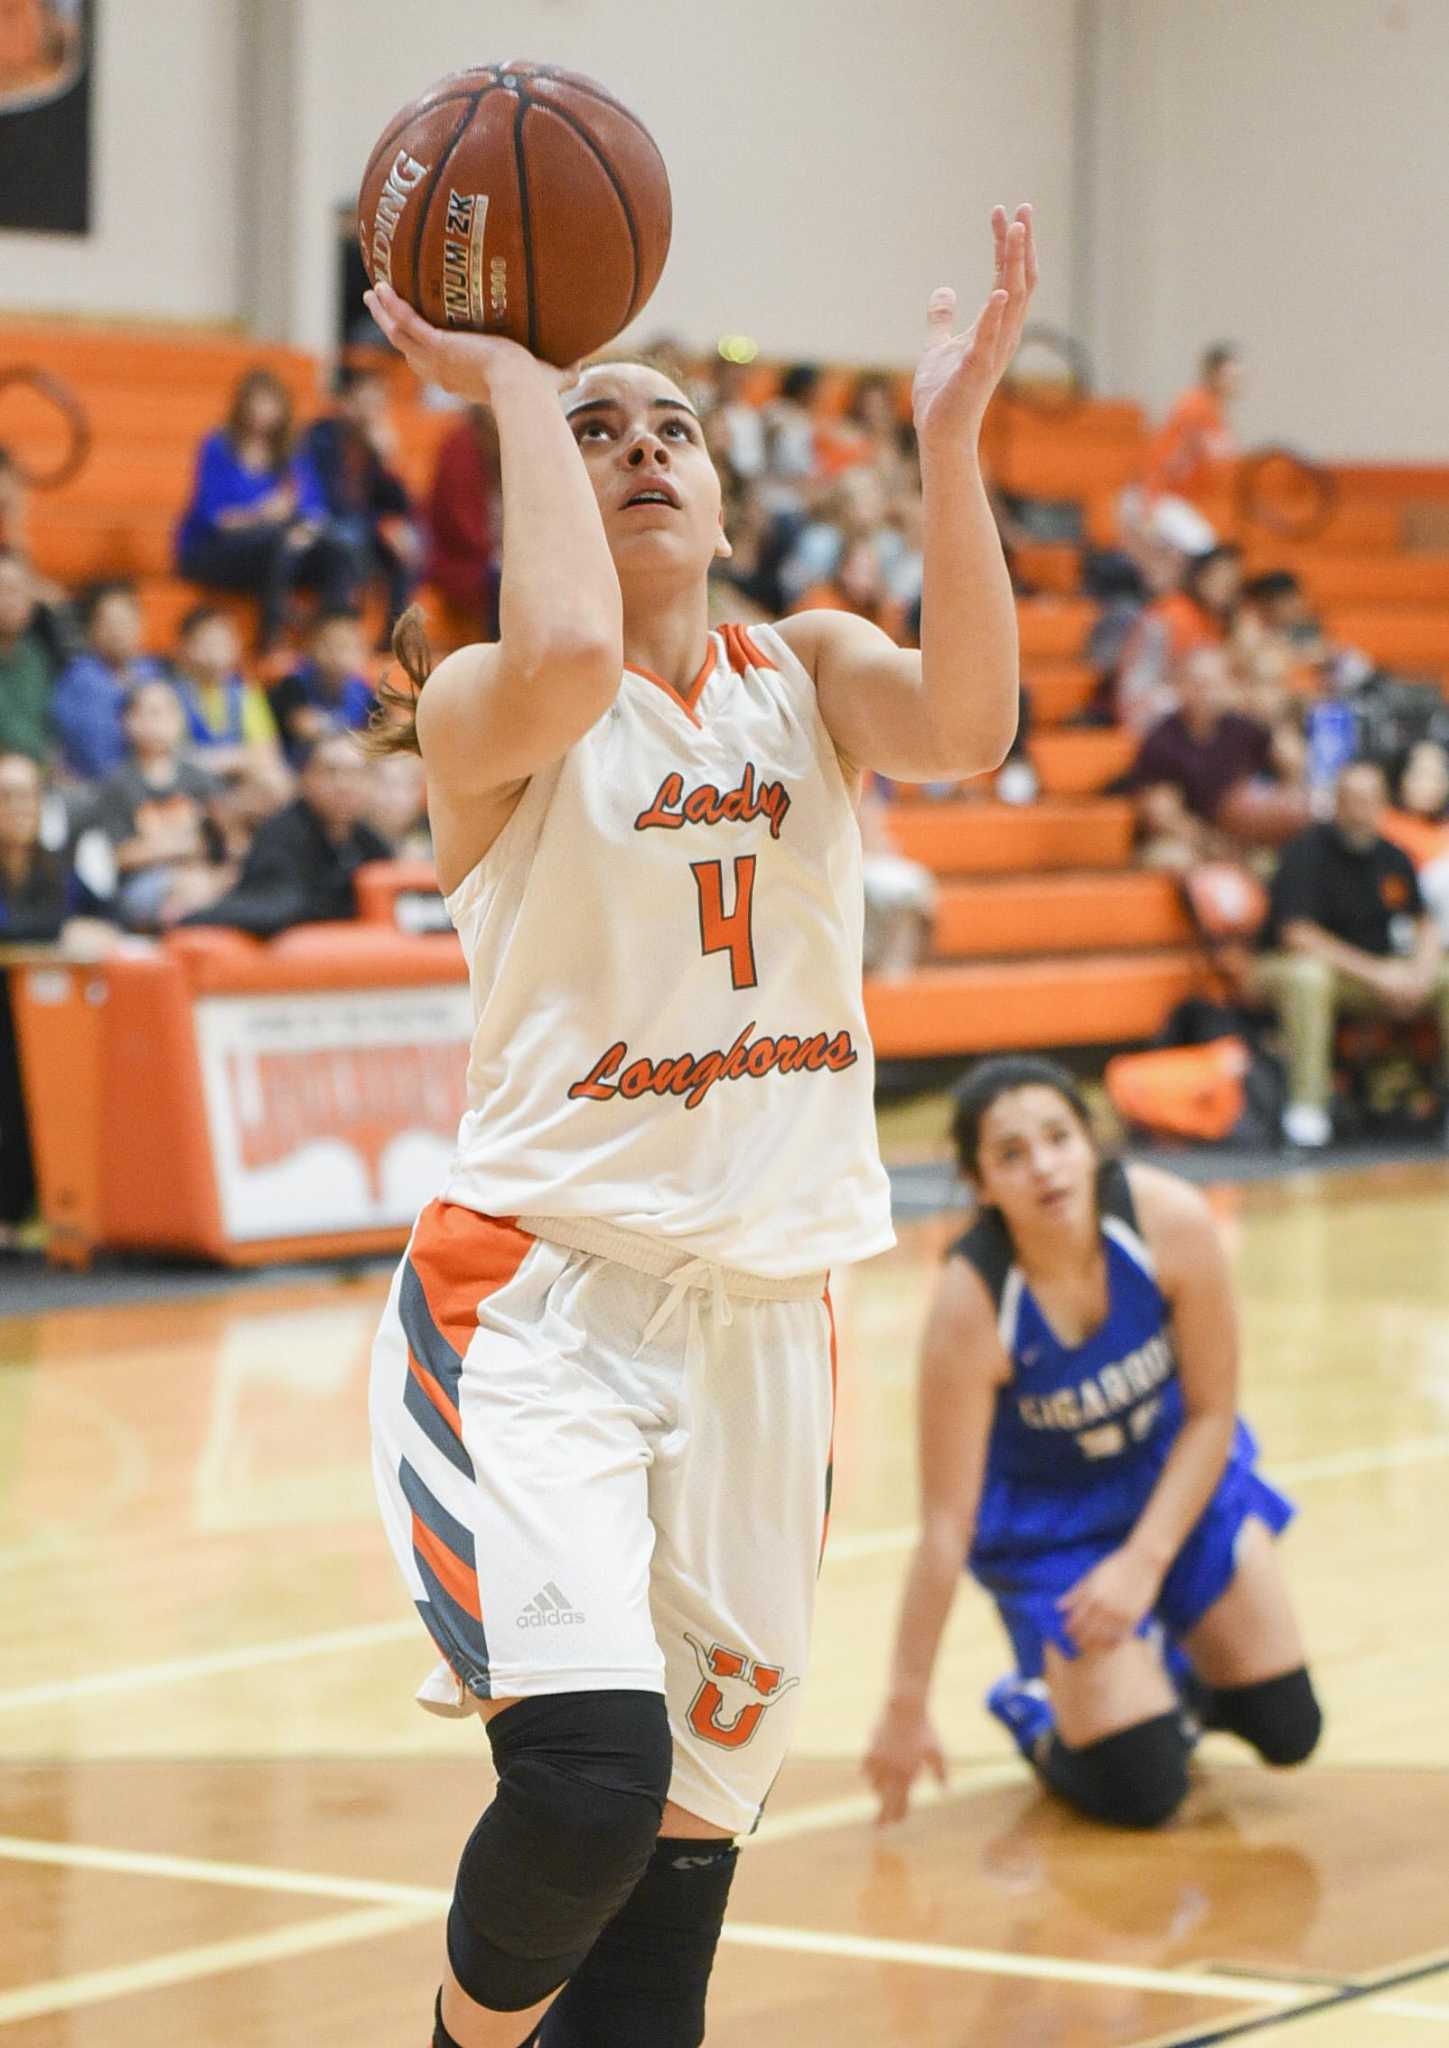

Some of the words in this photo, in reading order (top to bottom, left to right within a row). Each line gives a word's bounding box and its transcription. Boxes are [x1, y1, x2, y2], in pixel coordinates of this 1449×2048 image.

[372, 149, 429, 287] LDING
[634, 762, 791, 840] Lady
[689, 854, 758, 991] 4
[567, 1021, 857, 1110] Longhorns
[515, 1609, 587, 1630] adidas
